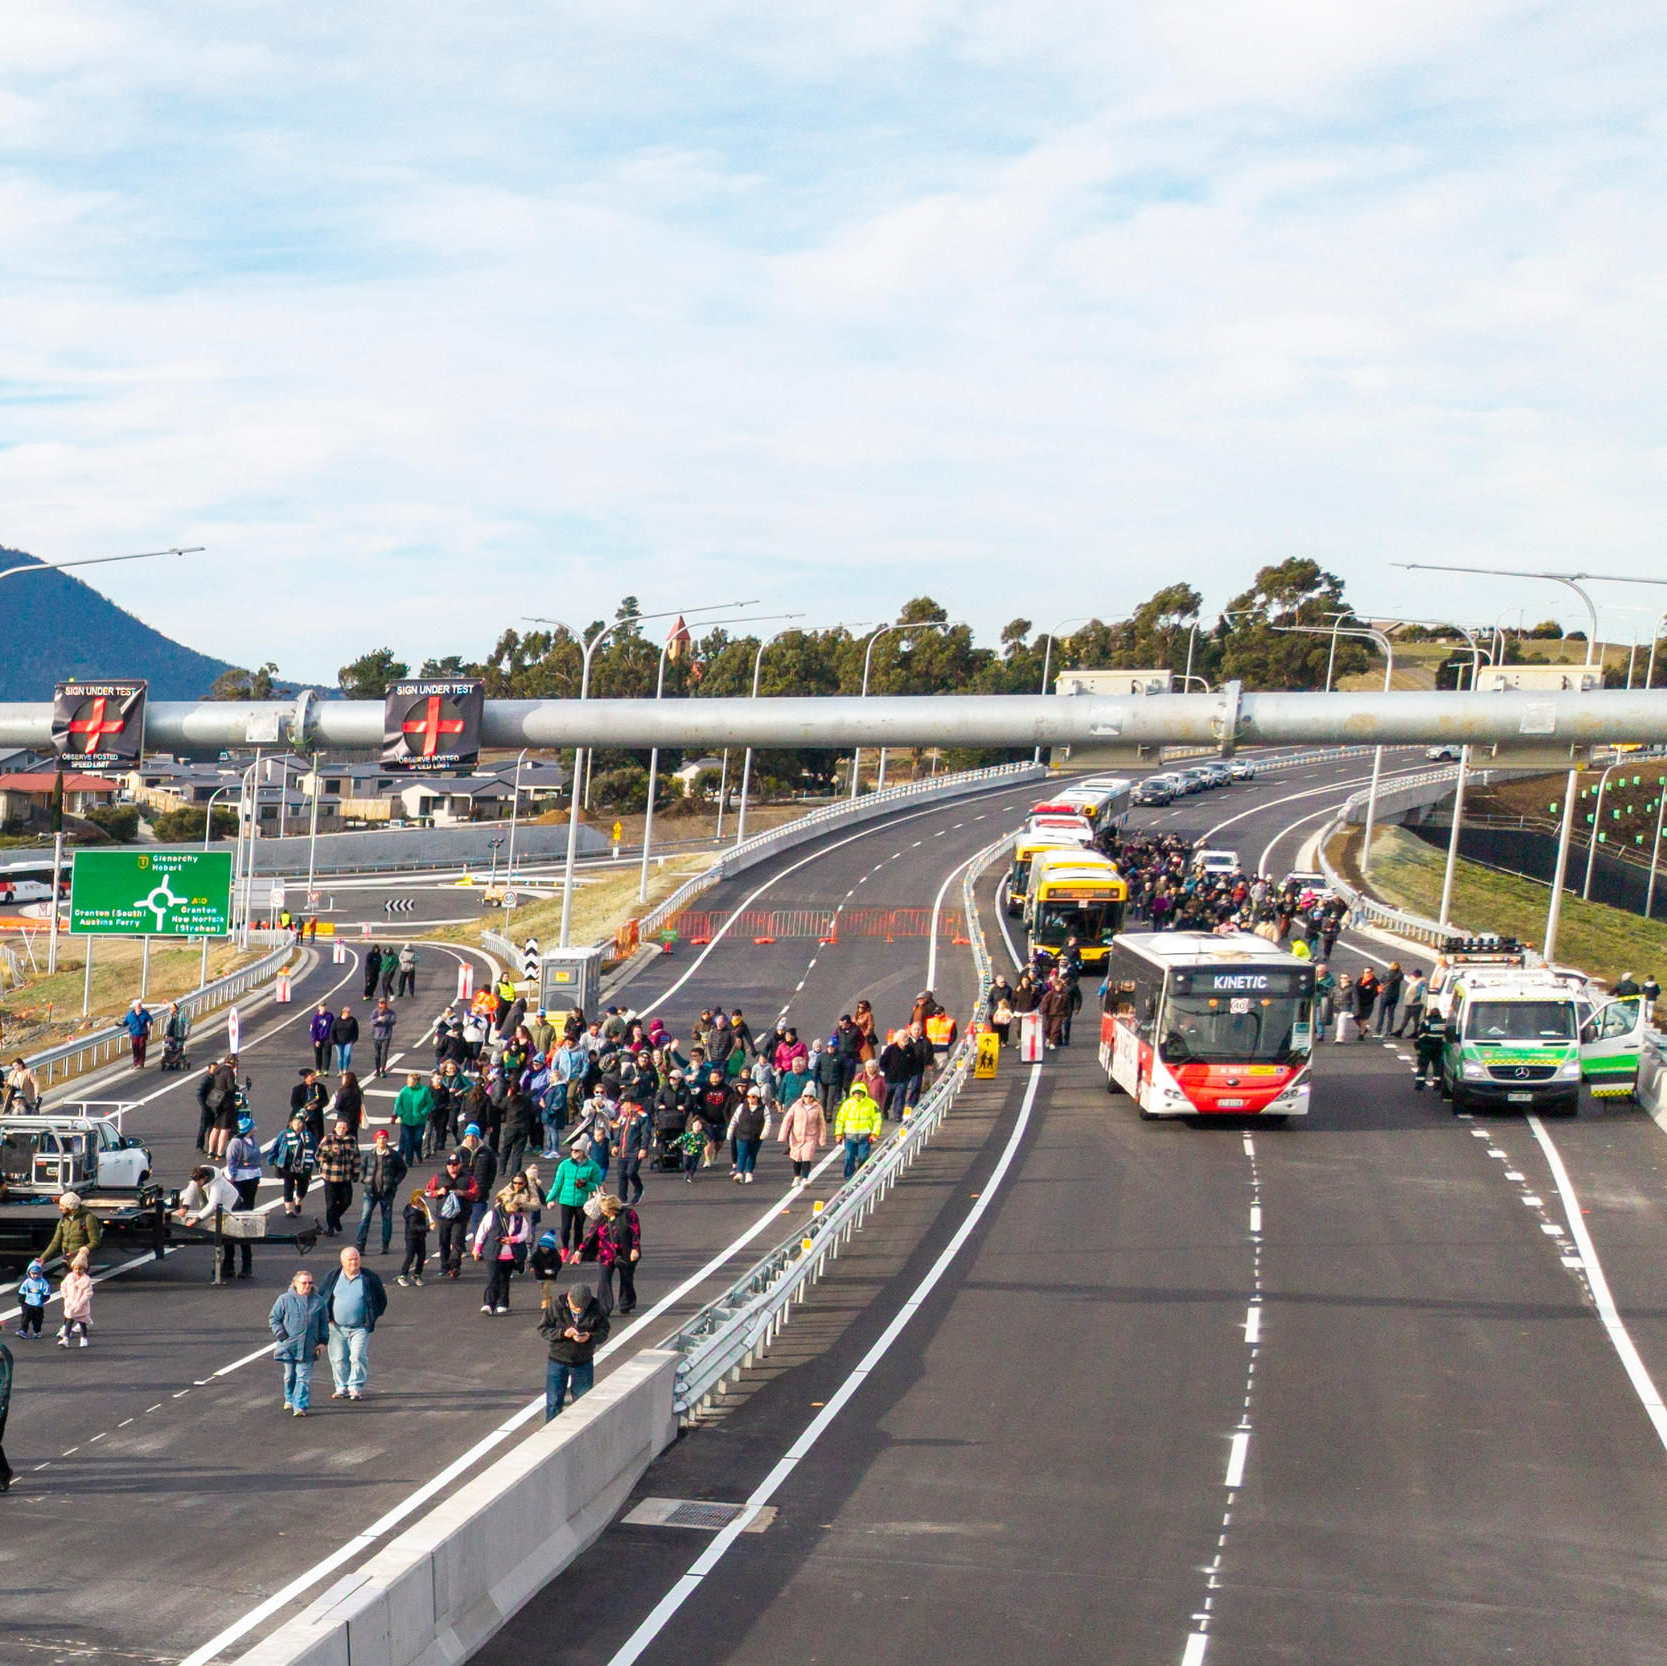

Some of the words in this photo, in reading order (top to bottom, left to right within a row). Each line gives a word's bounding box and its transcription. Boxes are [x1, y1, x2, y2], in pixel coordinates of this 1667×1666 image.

[65, 686, 87, 696] SIGN
[87, 686, 114, 696] UNDER
[116, 687, 136, 696] TEST
[397, 685, 417, 695] SIGN
[419, 684, 450, 694] UNDER
[452, 684, 474, 694] TEST
[153, 855, 198, 863] Glenorchy
[1214, 975, 1267, 989] KINETIC
